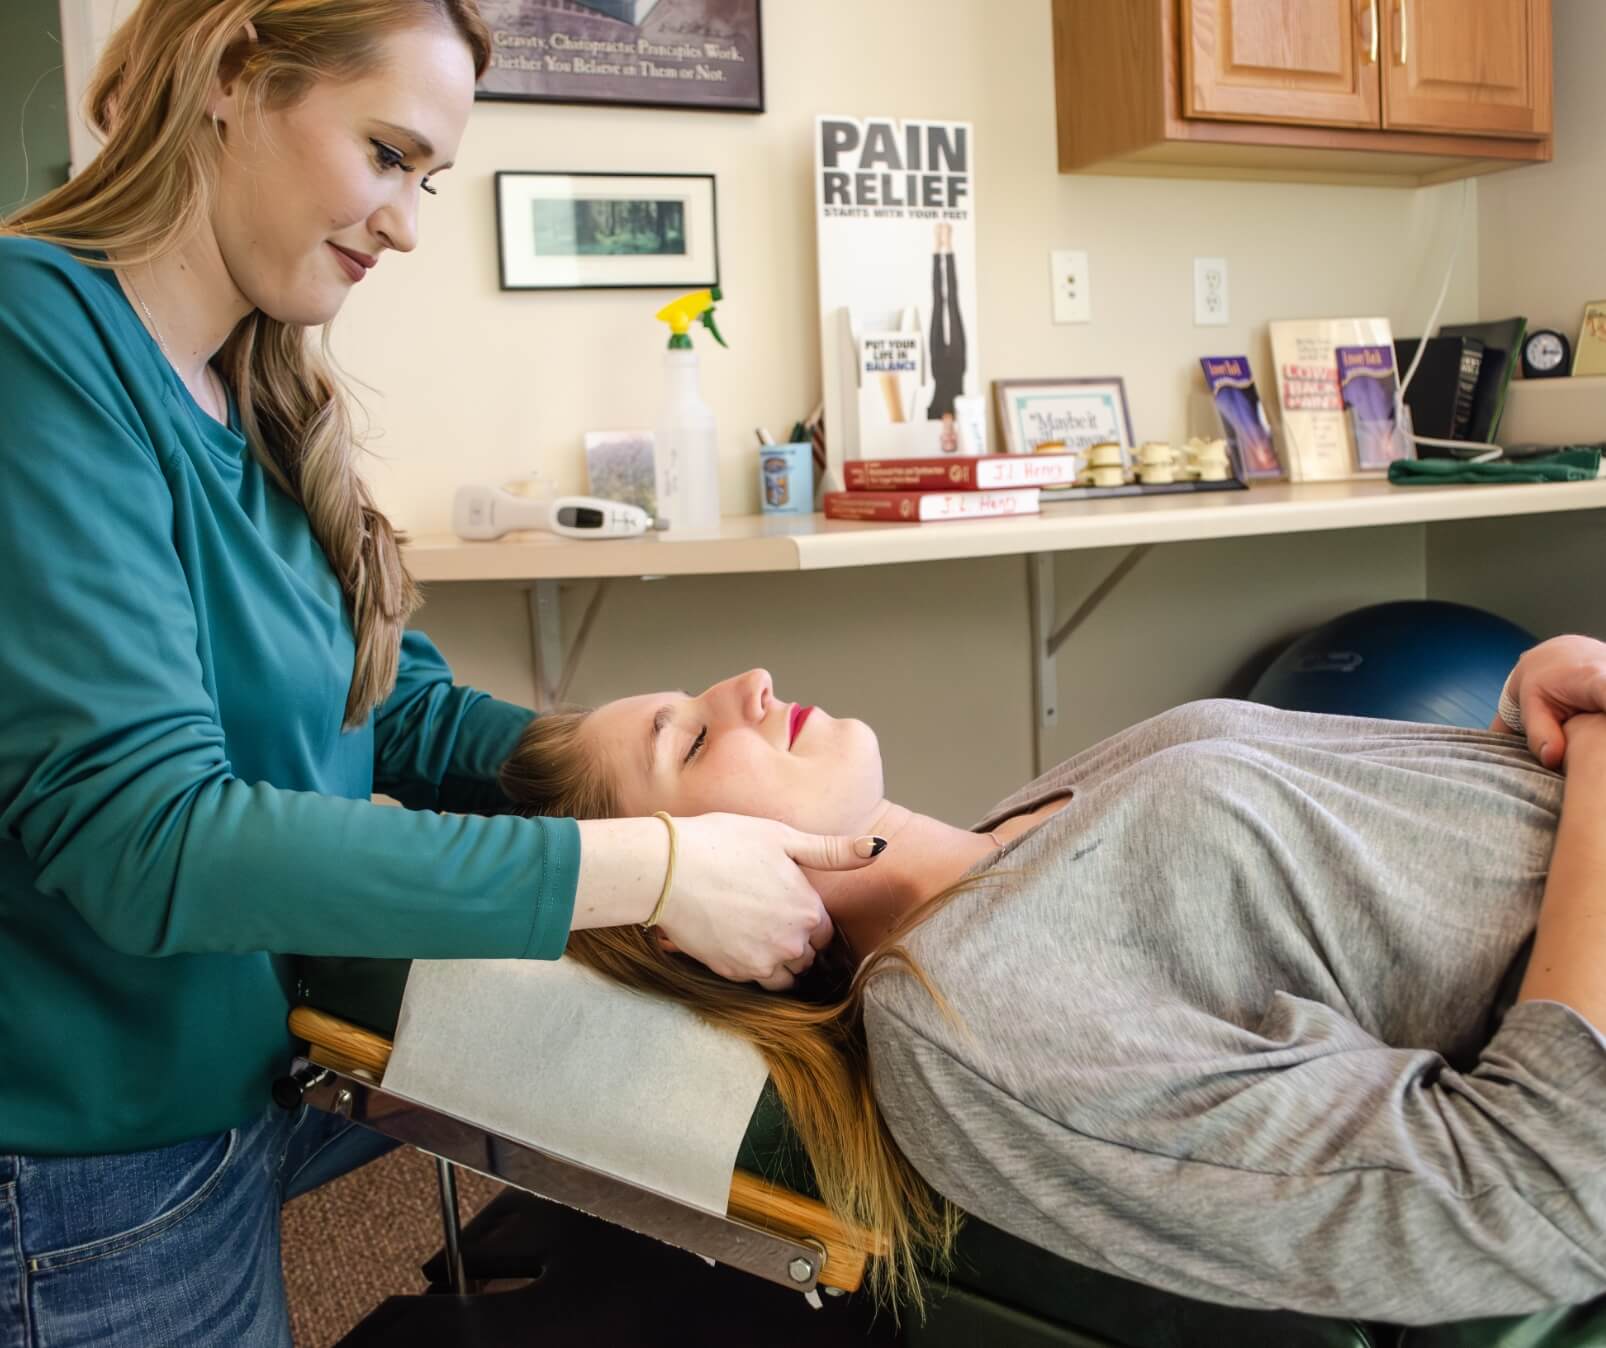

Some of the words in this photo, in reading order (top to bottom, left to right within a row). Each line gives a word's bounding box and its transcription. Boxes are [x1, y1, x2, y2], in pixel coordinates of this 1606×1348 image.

[493, 30, 548, 50] Gravity,
[550, 33, 635, 56] Chiropractic
[638, 39, 702, 61] Principles
[489, 54, 542, 71] hether
[544, 55, 571, 72] You
[573, 58, 620, 75] Believe
[623, 64, 637, 75] in
[639, 61, 677, 79] Them
[679, 67, 694, 80] or
[695, 65, 727, 81] Not.
[821, 120, 967, 173] PAIN
[823, 171, 968, 208] RELIEF
[824, 208, 869, 218] STARTS
[873, 209, 904, 218] WITH
[908, 209, 938, 219] YOUR
[942, 210, 968, 220] FEET
[865, 340, 885, 350] PUT
[888, 340, 916, 349] YOUR
[873, 350, 894, 360] LIFE
[866, 361, 916, 372] BALANCE
